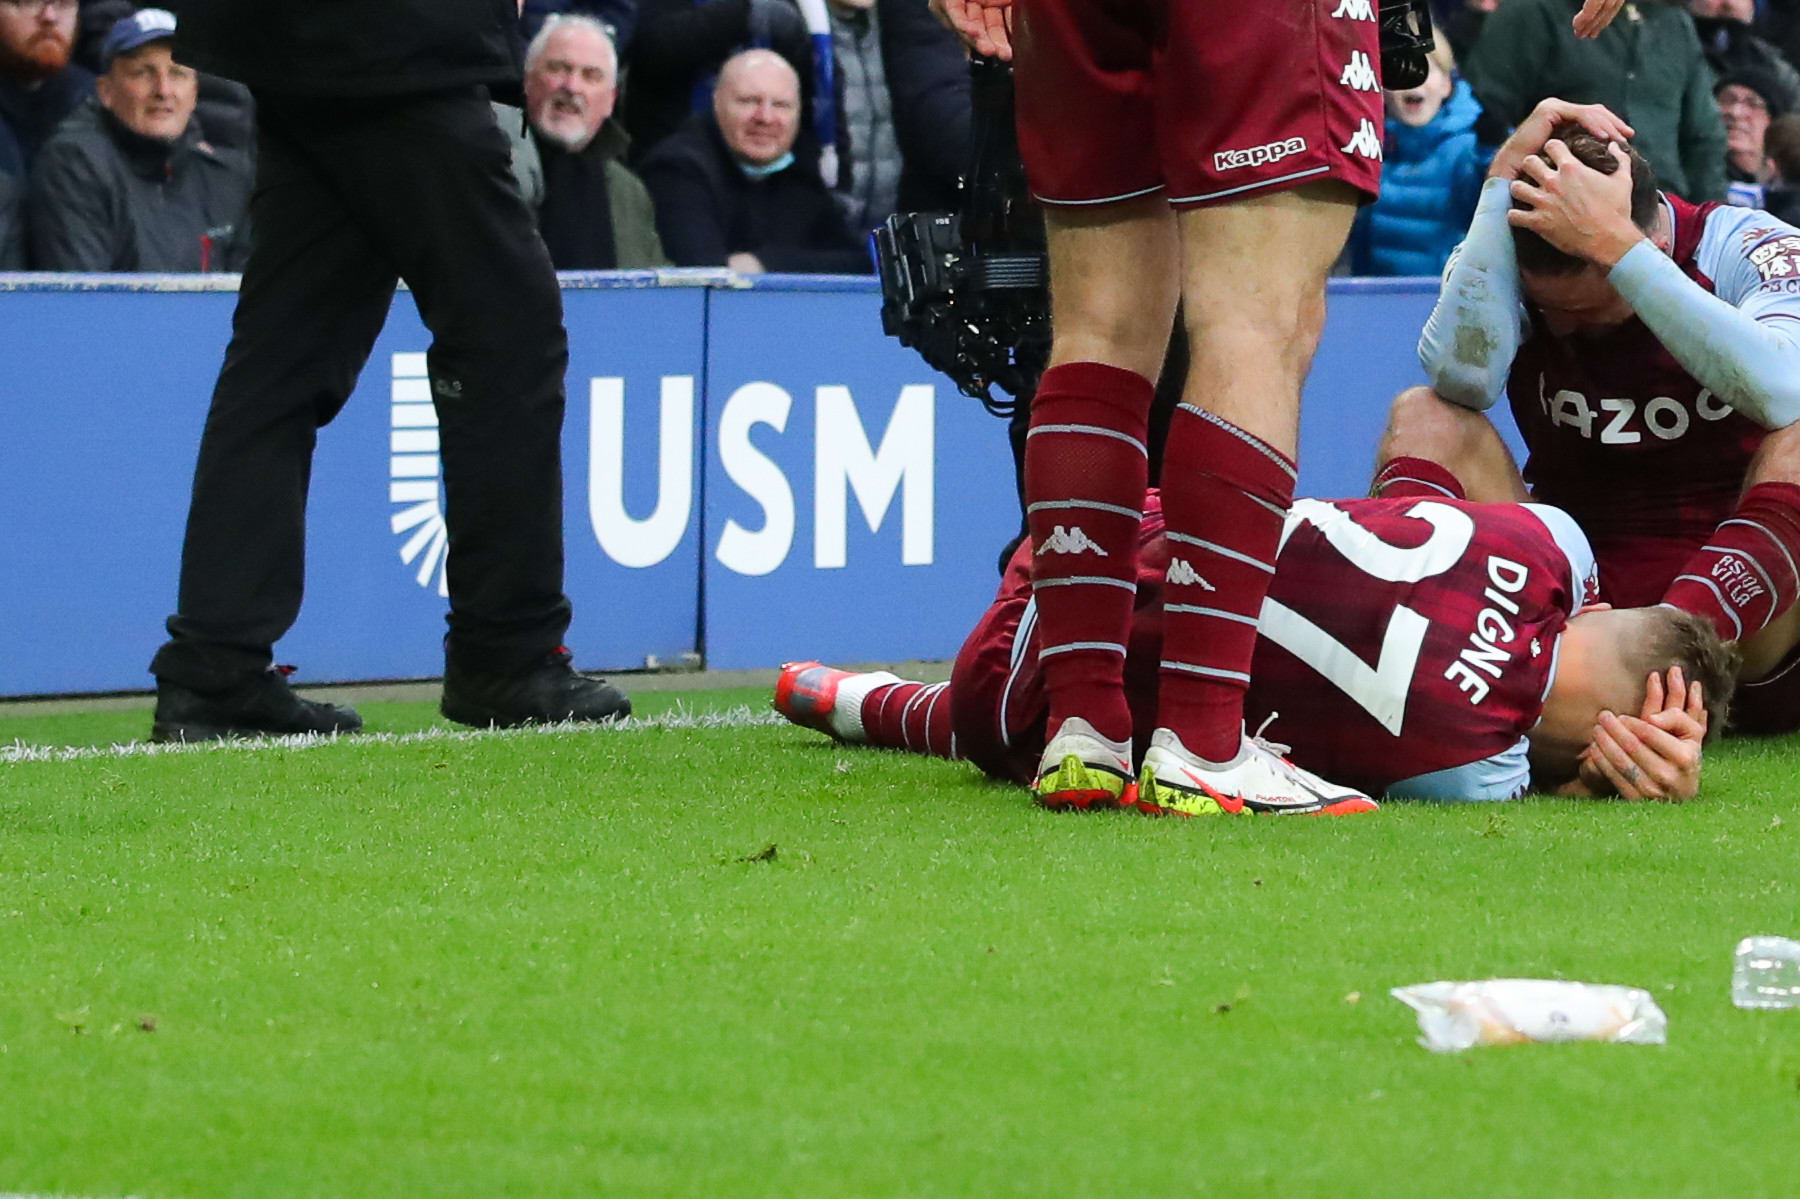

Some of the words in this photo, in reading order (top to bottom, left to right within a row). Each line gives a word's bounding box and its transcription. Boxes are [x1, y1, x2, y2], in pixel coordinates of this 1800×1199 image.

[1213, 136, 1307, 173] Kappa
[588, 375, 936, 577] USM
[1539, 371, 1734, 444] AZOO
[1257, 498, 1476, 738] 27
[1443, 554, 1531, 706] DIGNE
